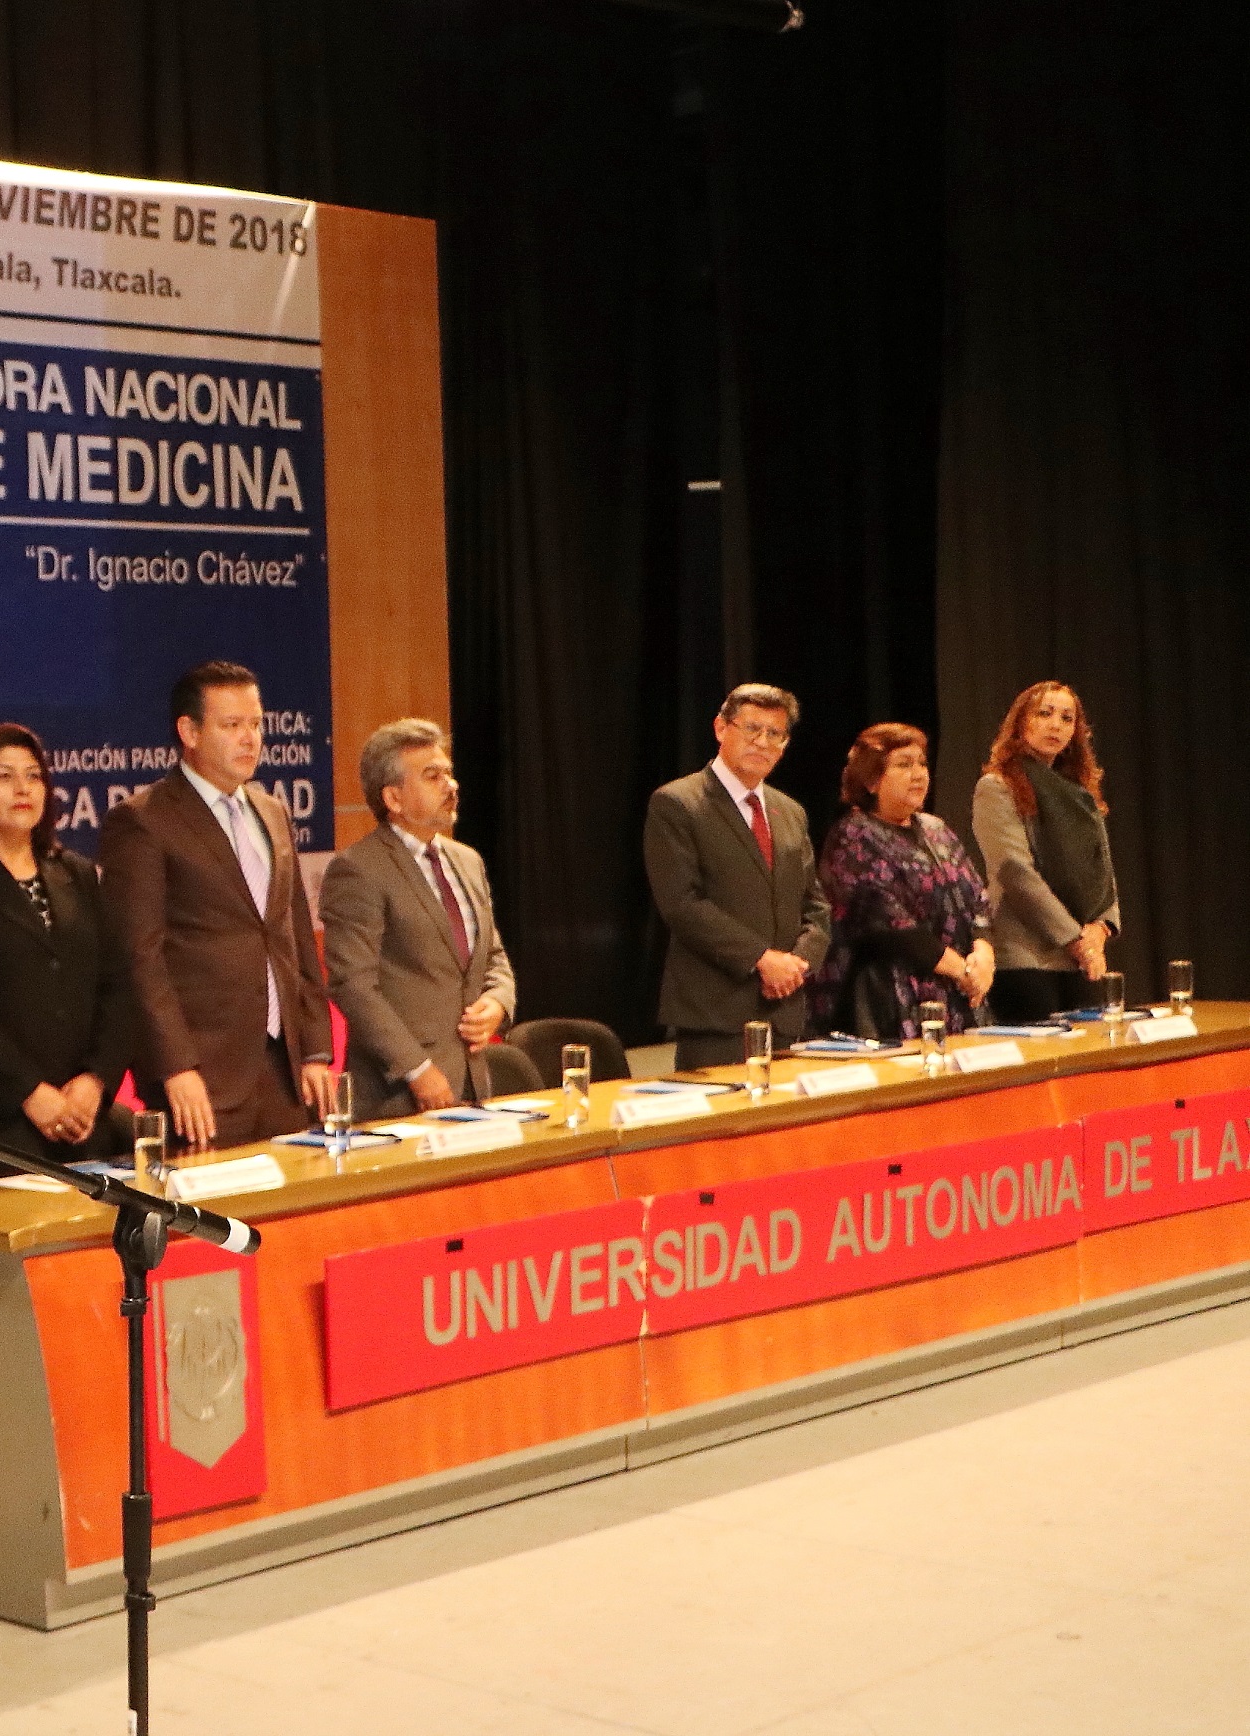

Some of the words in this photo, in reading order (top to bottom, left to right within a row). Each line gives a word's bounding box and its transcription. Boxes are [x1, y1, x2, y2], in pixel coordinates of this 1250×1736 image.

[173, 204, 217, 247] DE
[229, 210, 309, 258] 2018
[52, 256, 182, 299] Tlaxcala.
[85, 365, 302, 431] NACIONAL
[27, 431, 303, 513] MEDICINA
[87, 548, 188, 592] Ignacio
[261, 710, 312, 737] TICA:
[131, 748, 178, 769] PARA
[258, 738, 312, 766] ACIÓN
[422, 1208, 802, 1346] UNIVERSIDAD
[826, 1154, 1083, 1263] AUTONOMA
[1104, 1134, 1153, 1198] DE
[1170, 1118, 1250, 1184] TLA
